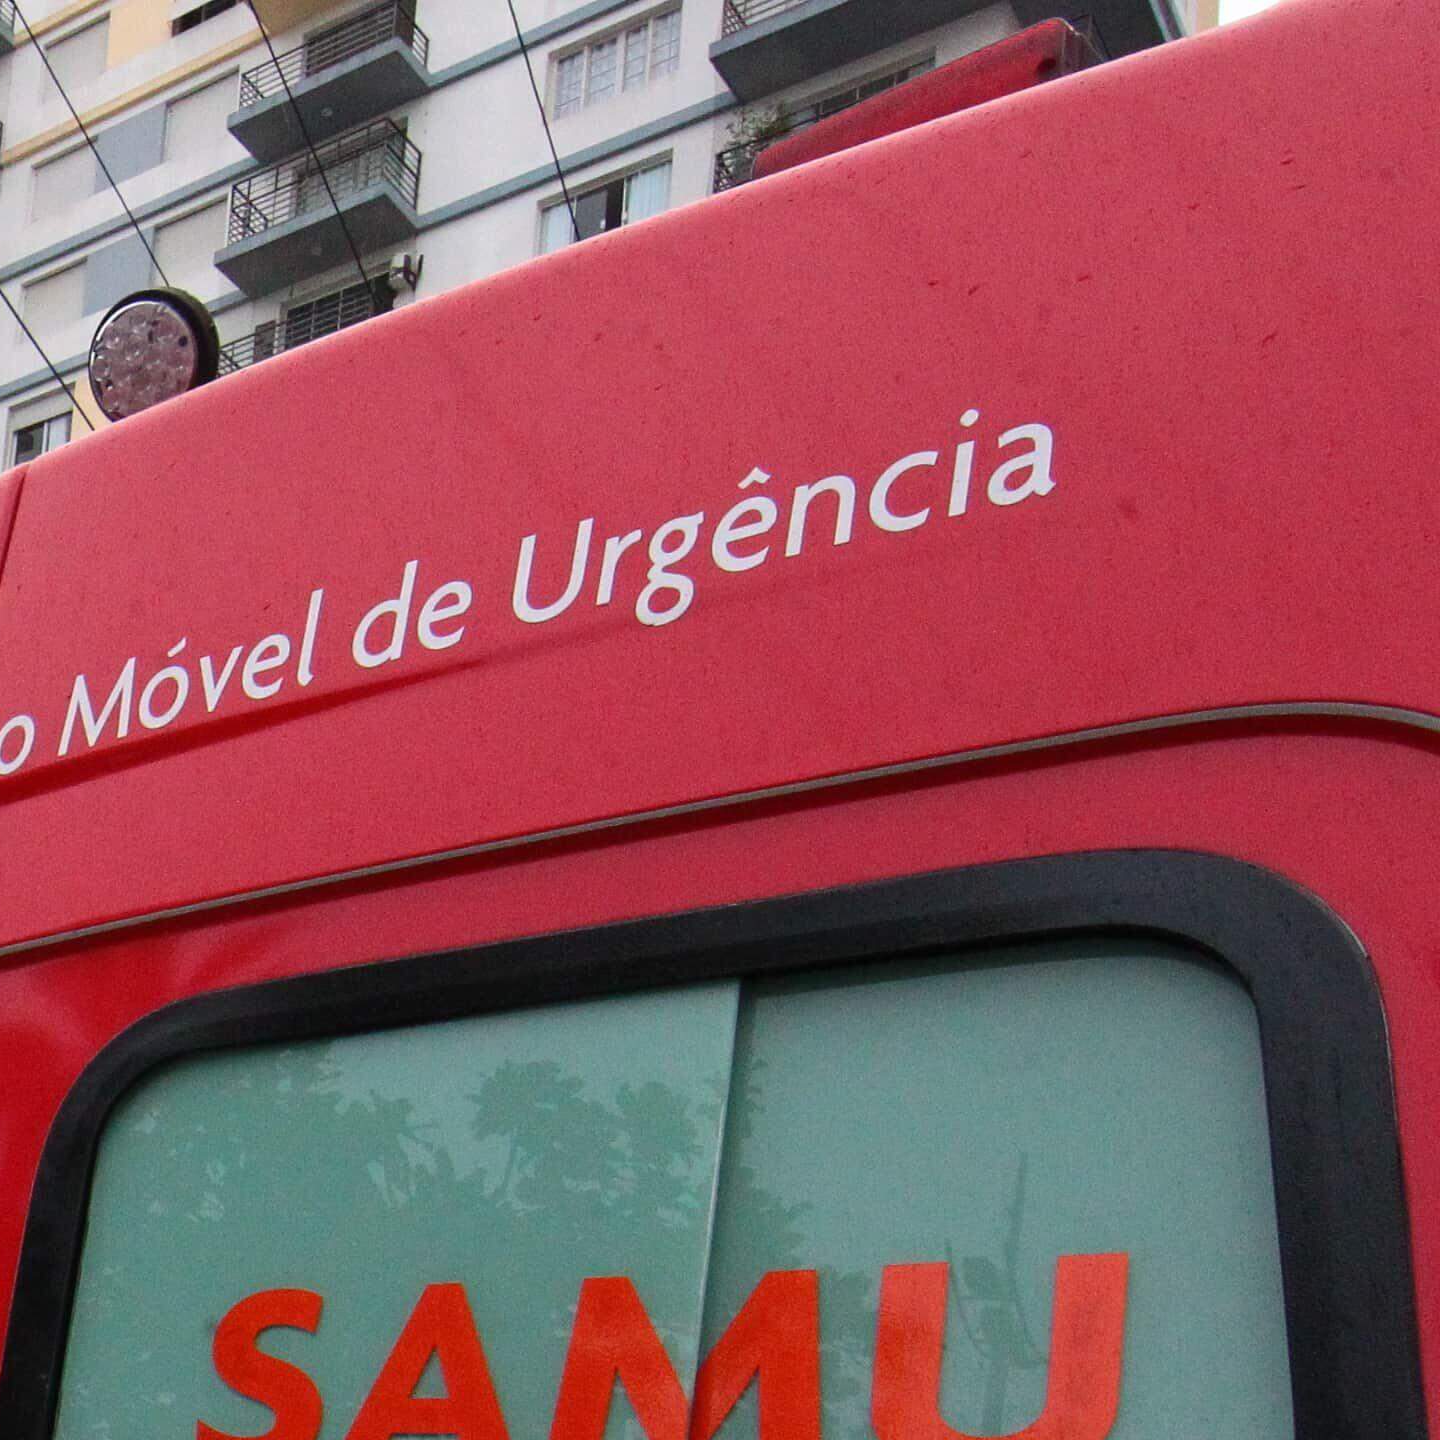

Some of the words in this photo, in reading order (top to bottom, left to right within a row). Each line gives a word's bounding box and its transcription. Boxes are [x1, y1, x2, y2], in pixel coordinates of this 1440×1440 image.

[57, 589, 324, 756] Móvel
[351, 560, 473, 668] de
[512, 408, 1057, 627] Urgência
